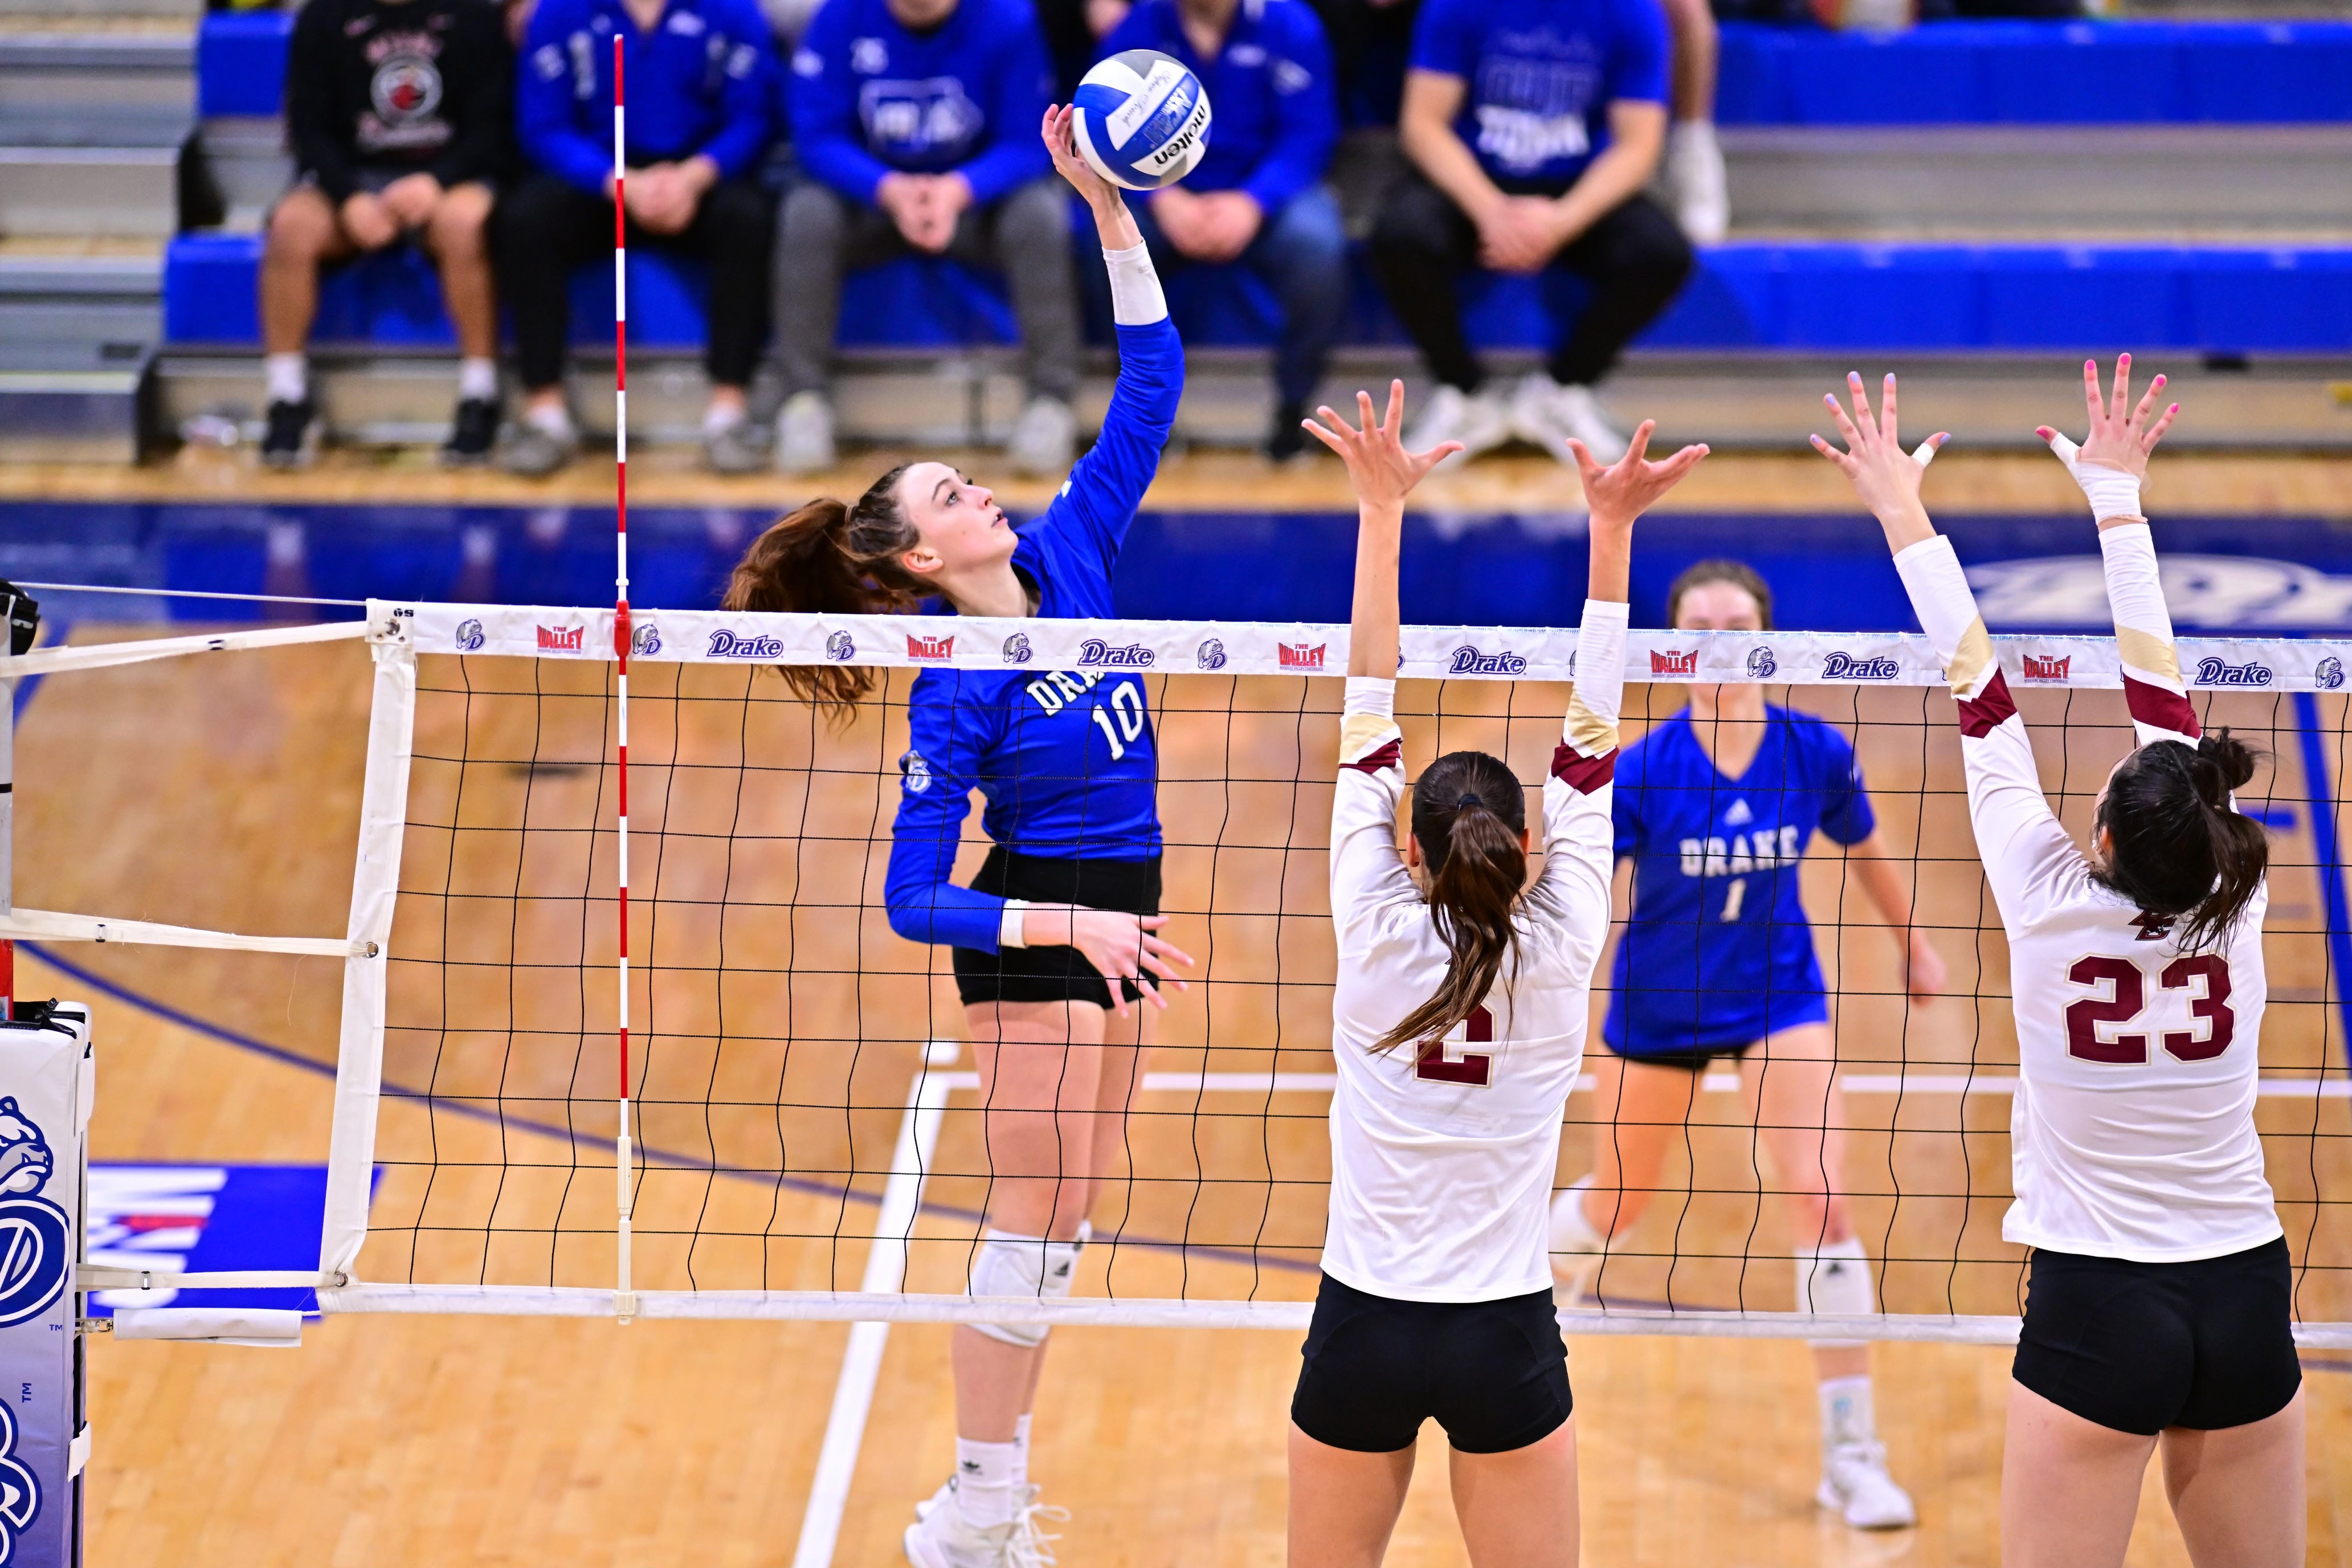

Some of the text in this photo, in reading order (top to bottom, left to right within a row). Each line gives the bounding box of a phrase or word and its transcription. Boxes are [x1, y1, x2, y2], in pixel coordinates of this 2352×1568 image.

[1154, 105, 1207, 165] molten
[537, 624, 584, 650] VALLEY
[707, 629, 783, 658] Drake
[906, 634, 954, 658] VALLEY
[1077, 639, 1154, 667] Drake
[1278, 642, 1326, 667] VALLEY
[1449, 646, 1526, 675] Drake
[1650, 650, 1698, 673] VALLEY
[1822, 651, 1898, 679] Drake
[2023, 655, 2071, 679] VALLEY
[2194, 657, 2272, 685] Drake
[1092, 681, 1144, 760] 10
[1679, 825, 1799, 877] DRAKE
[1720, 879, 1746, 922] 1
[2062, 952, 2237, 1065] 23
[22, 1383, 32, 1403] TM
